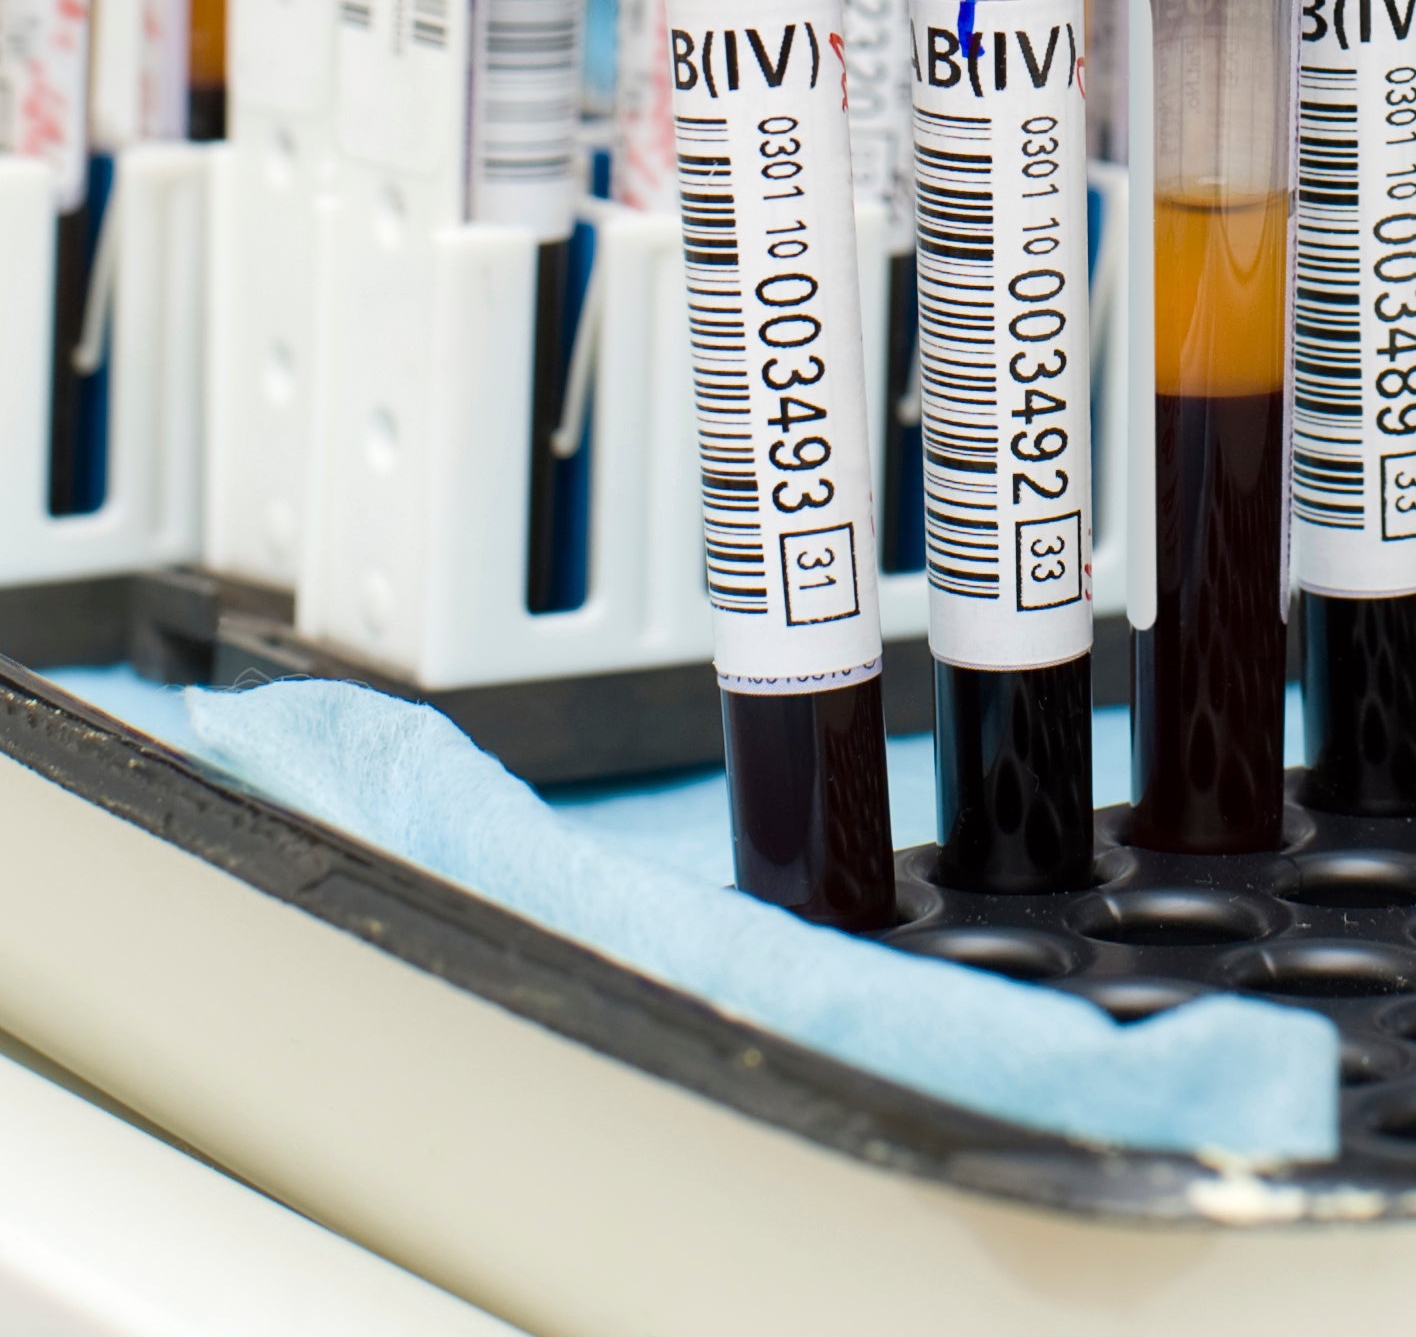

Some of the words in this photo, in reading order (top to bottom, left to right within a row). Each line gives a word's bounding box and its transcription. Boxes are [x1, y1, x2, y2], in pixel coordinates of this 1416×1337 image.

[671, 21, 821, 99] B(IV)
[757, 115, 806, 201] 0301
[1020, 115, 1060, 199] 0301
[766, 219, 809, 259] 10
[1022, 217, 1060, 255] 10
[754, 272, 835, 514] 003493
[1008, 268, 1069, 505] 003492
[796, 548, 837, 591] 31
[1030, 535, 1066, 583] 33
